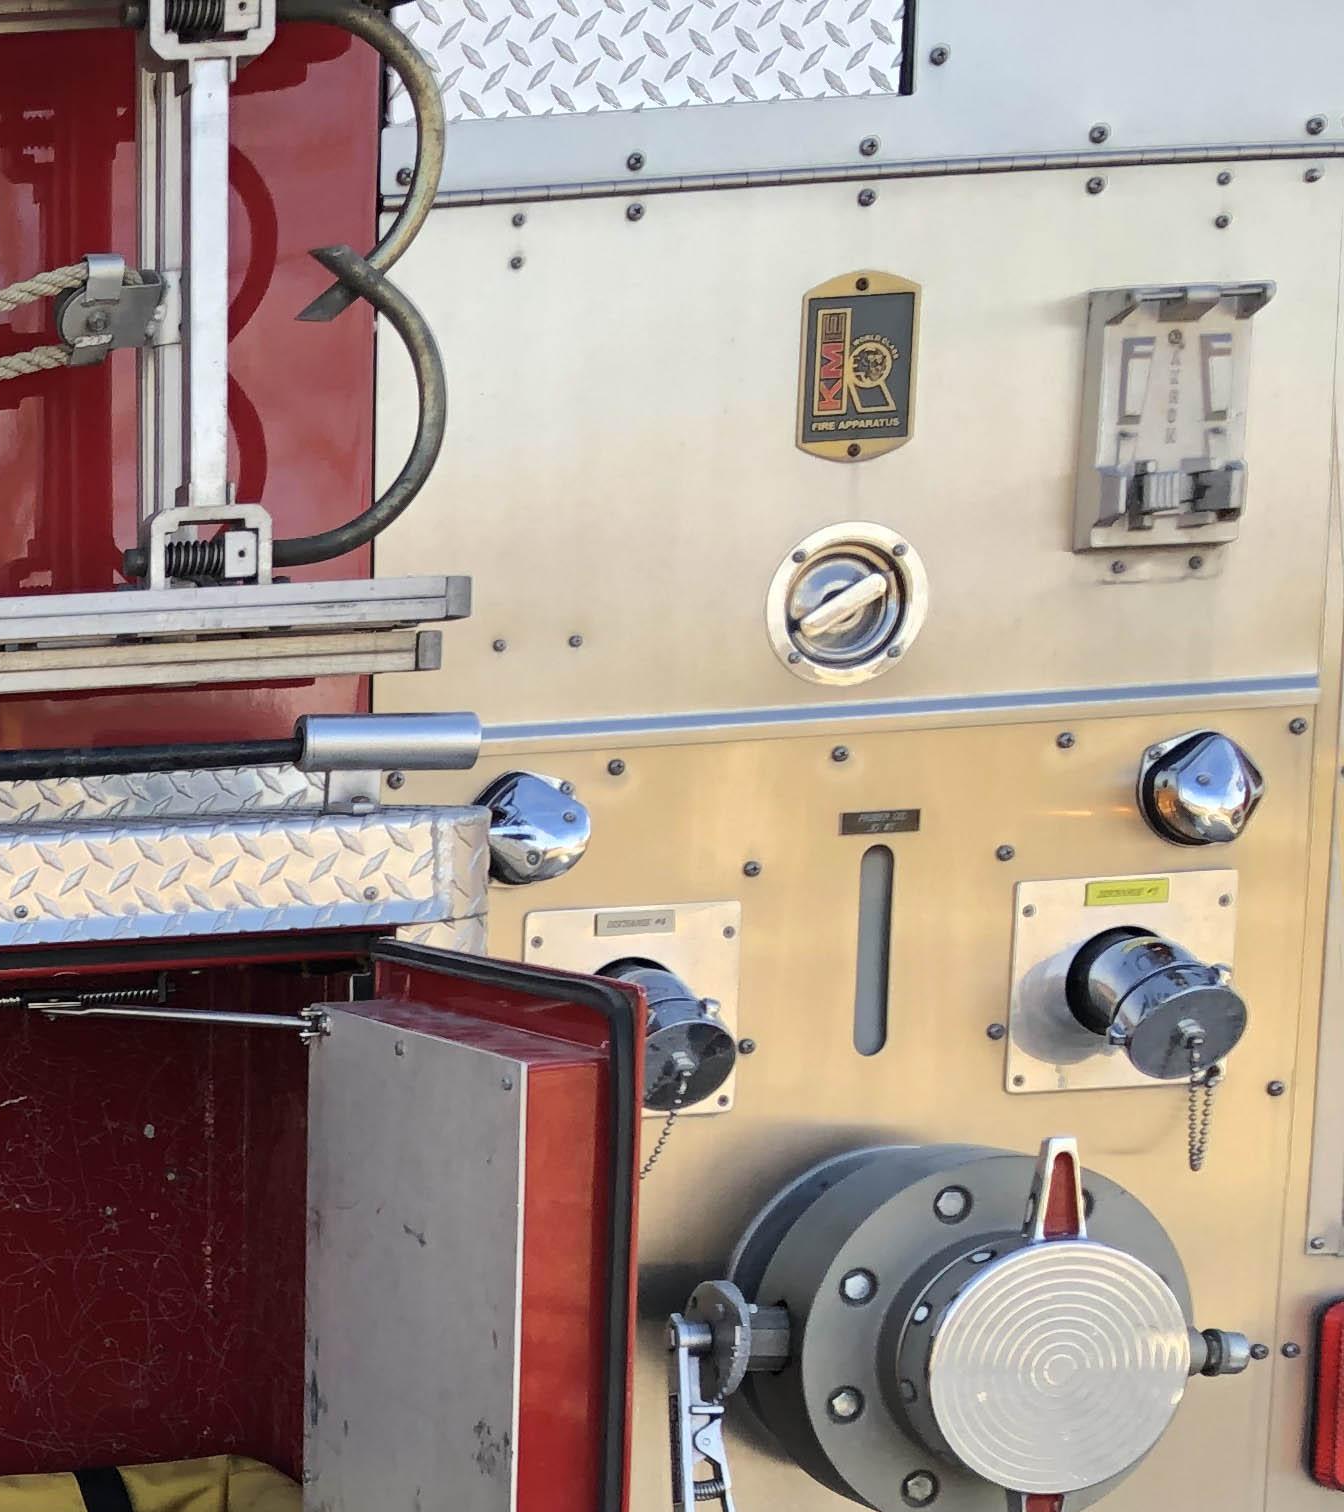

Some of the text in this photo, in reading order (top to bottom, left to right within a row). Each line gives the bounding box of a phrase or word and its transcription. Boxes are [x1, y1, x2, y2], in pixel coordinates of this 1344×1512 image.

[818, 313, 846, 411] KME
[812, 417, 901, 432] FIRE APPARATUS
